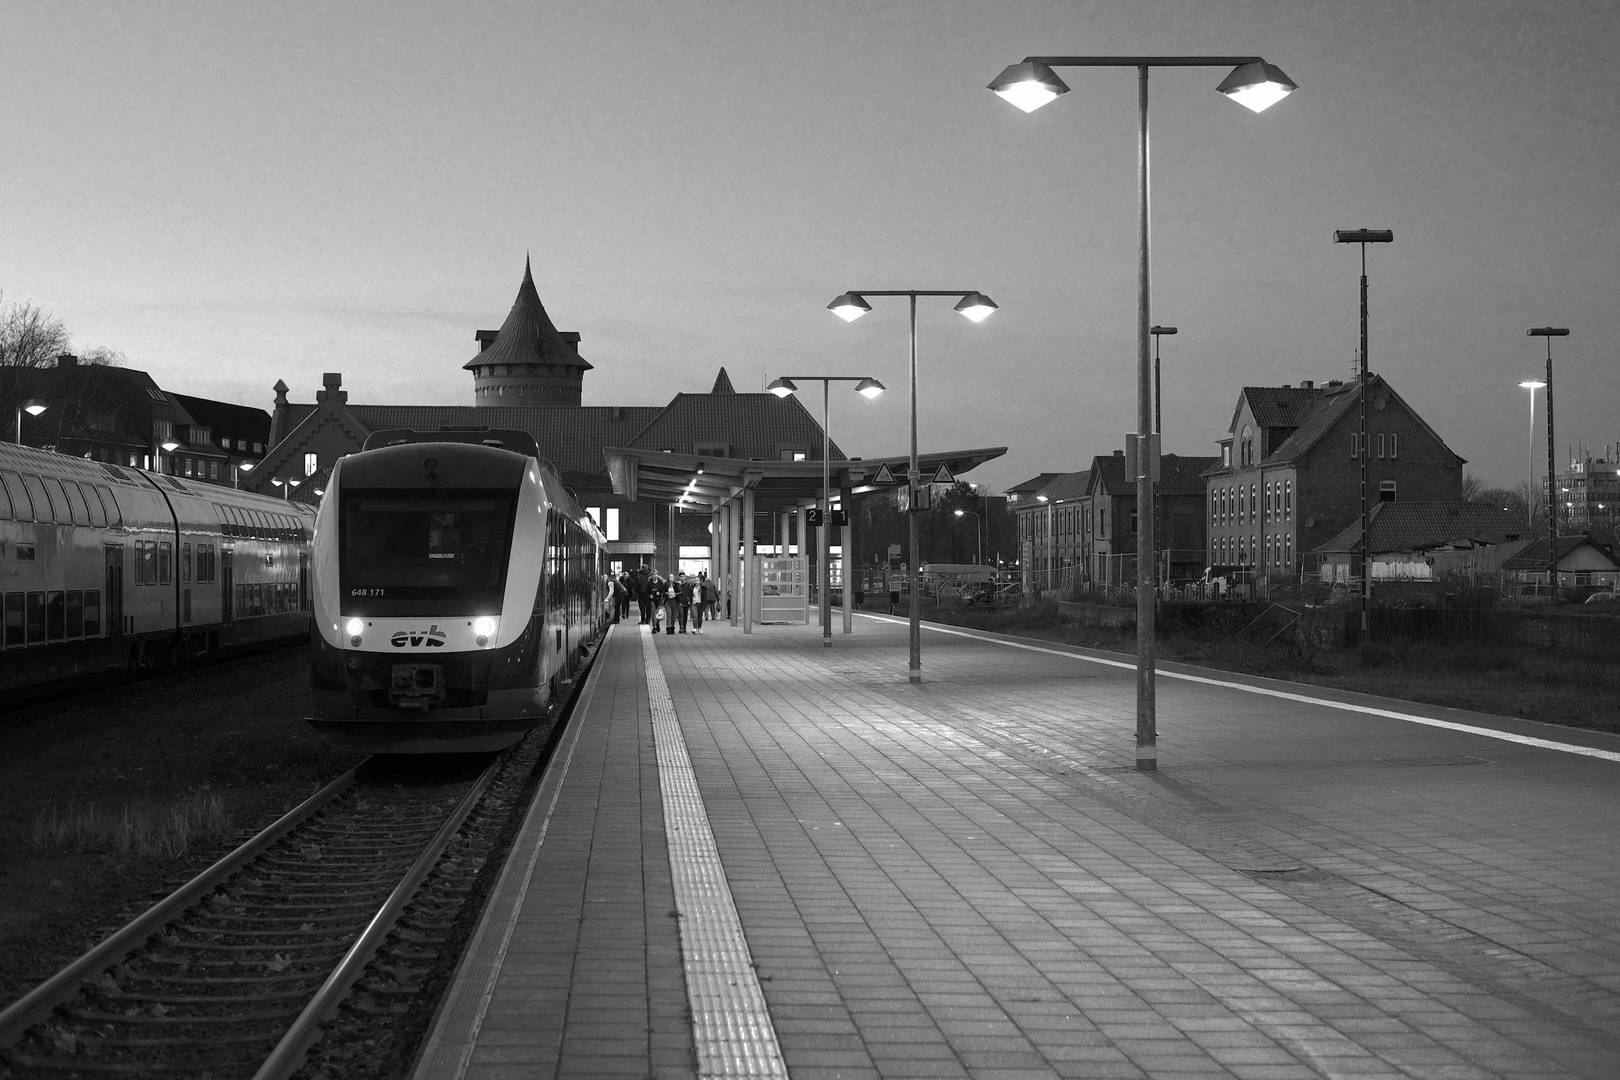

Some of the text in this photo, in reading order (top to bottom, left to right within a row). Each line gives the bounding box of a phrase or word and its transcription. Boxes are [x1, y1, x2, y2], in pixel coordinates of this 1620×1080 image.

[808, 510, 817, 522] 2
[840, 510, 846, 522] 1
[351, 588, 384, 597] 648 171
[390, 624, 447, 648] evb
